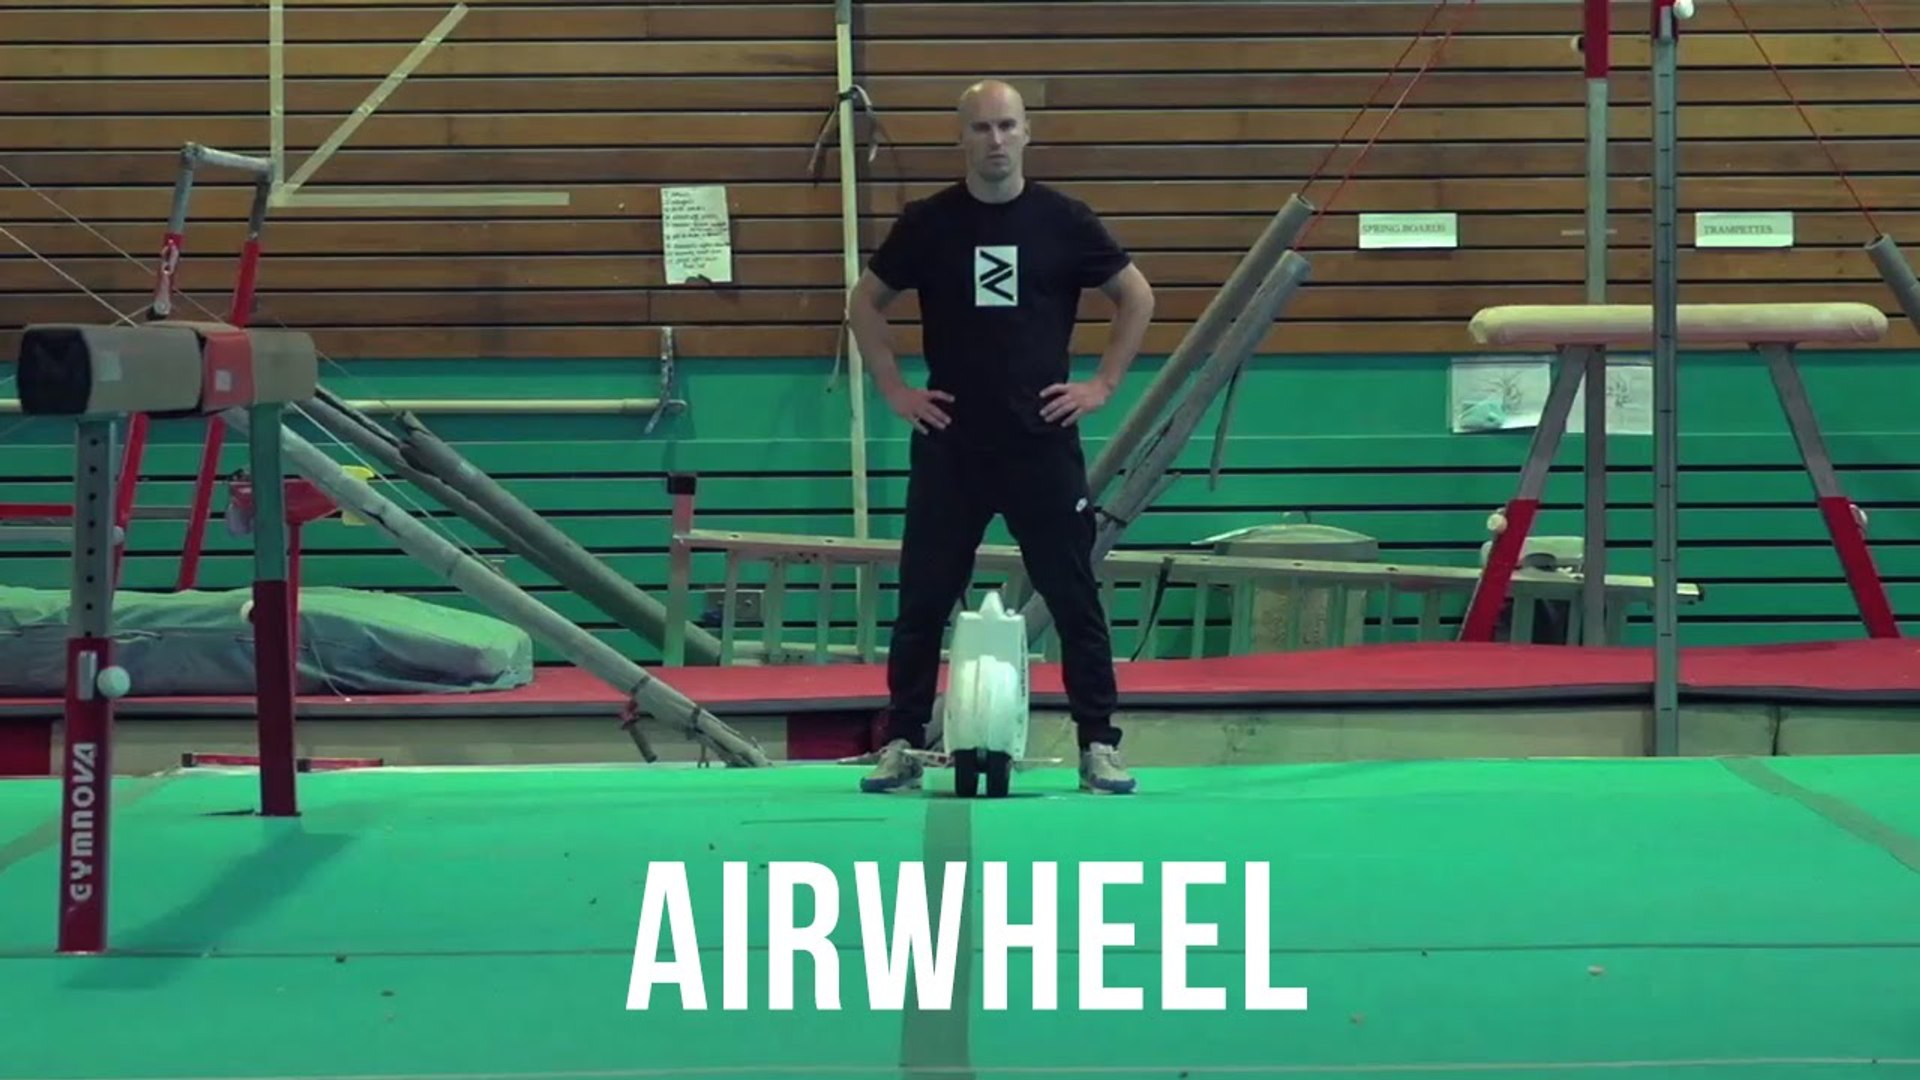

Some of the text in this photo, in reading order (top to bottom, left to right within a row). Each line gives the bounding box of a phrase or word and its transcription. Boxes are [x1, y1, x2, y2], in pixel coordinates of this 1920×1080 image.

[1361, 224, 1446, 234] SPRING BOARDS
[1703, 225, 1774, 235] TRAMPETTES
